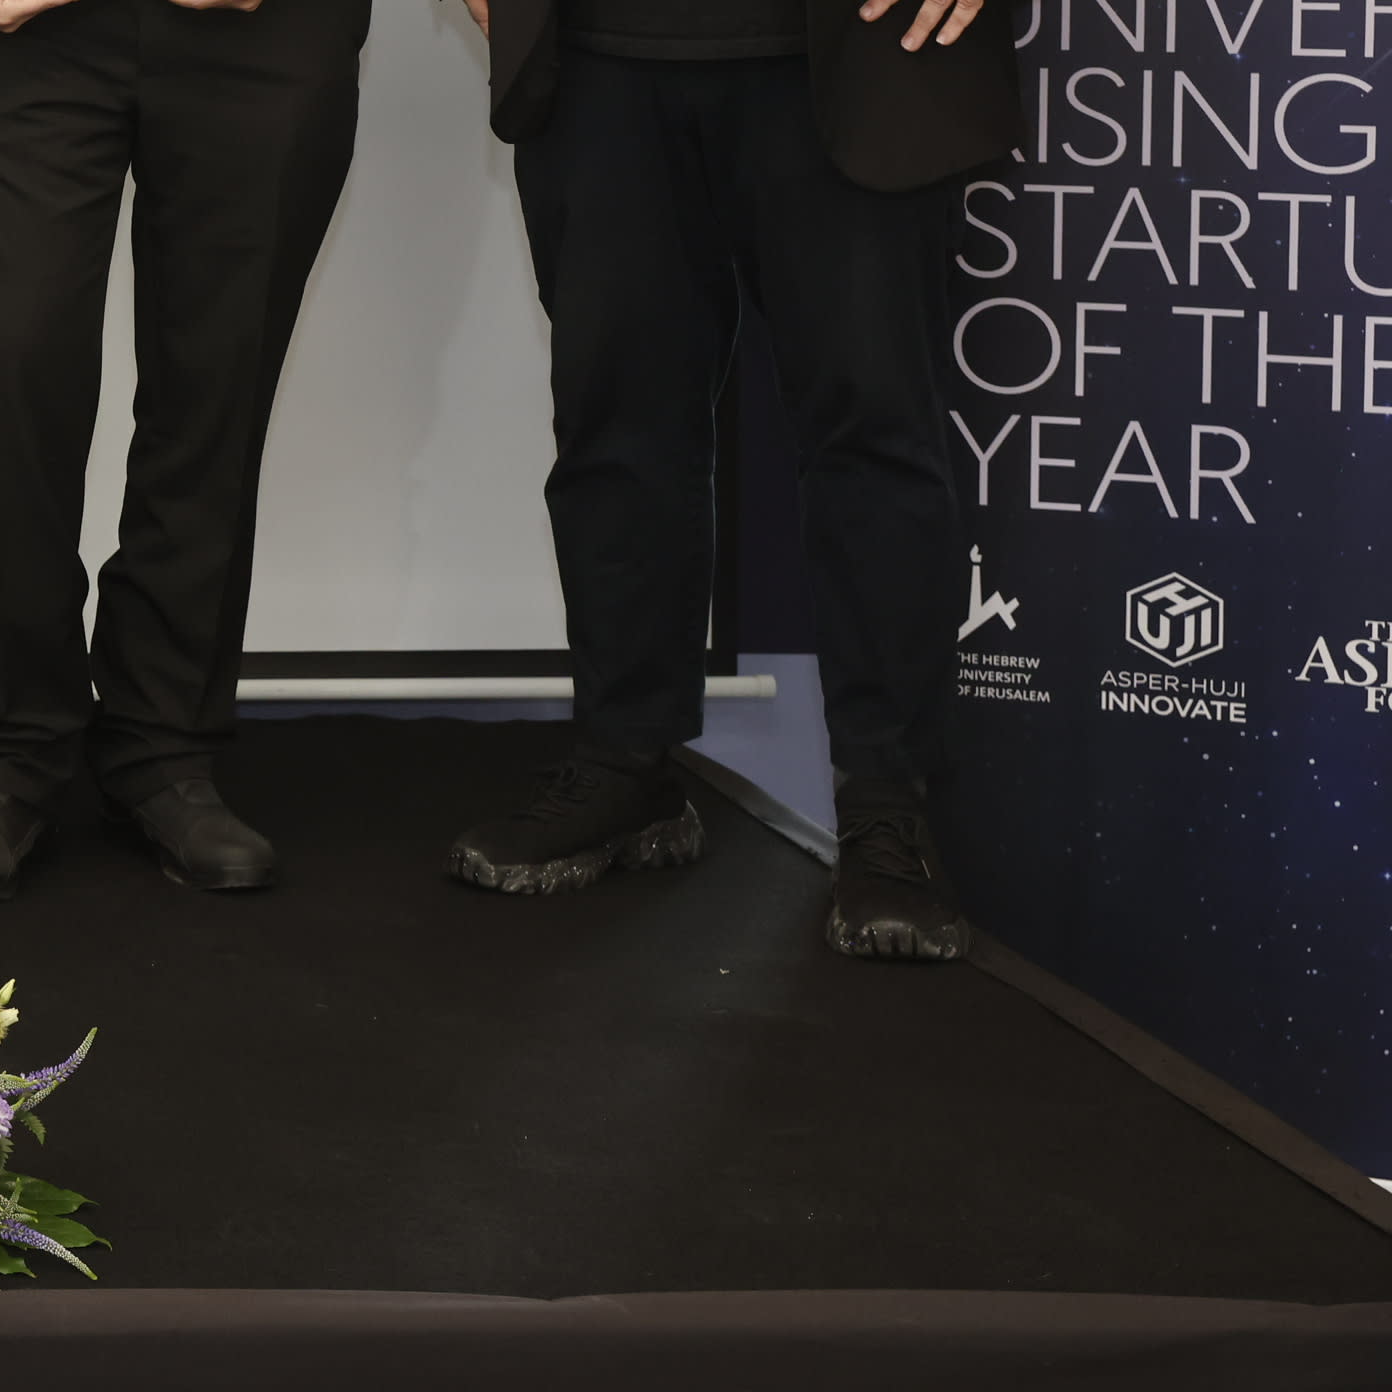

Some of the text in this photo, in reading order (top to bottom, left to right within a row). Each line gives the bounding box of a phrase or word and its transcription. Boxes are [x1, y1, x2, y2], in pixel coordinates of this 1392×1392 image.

[1011, 67, 1377, 175] ISING
[953, 297, 1392, 414] OF THE
[949, 409, 1256, 524] YEAR
[983, 654, 1040, 669] HEBREW
[974, 686, 1050, 703] JERUSALEM
[1100, 670, 1245, 698] ASPER-HUJI
[1101, 691, 1246, 723] INNOVATE
